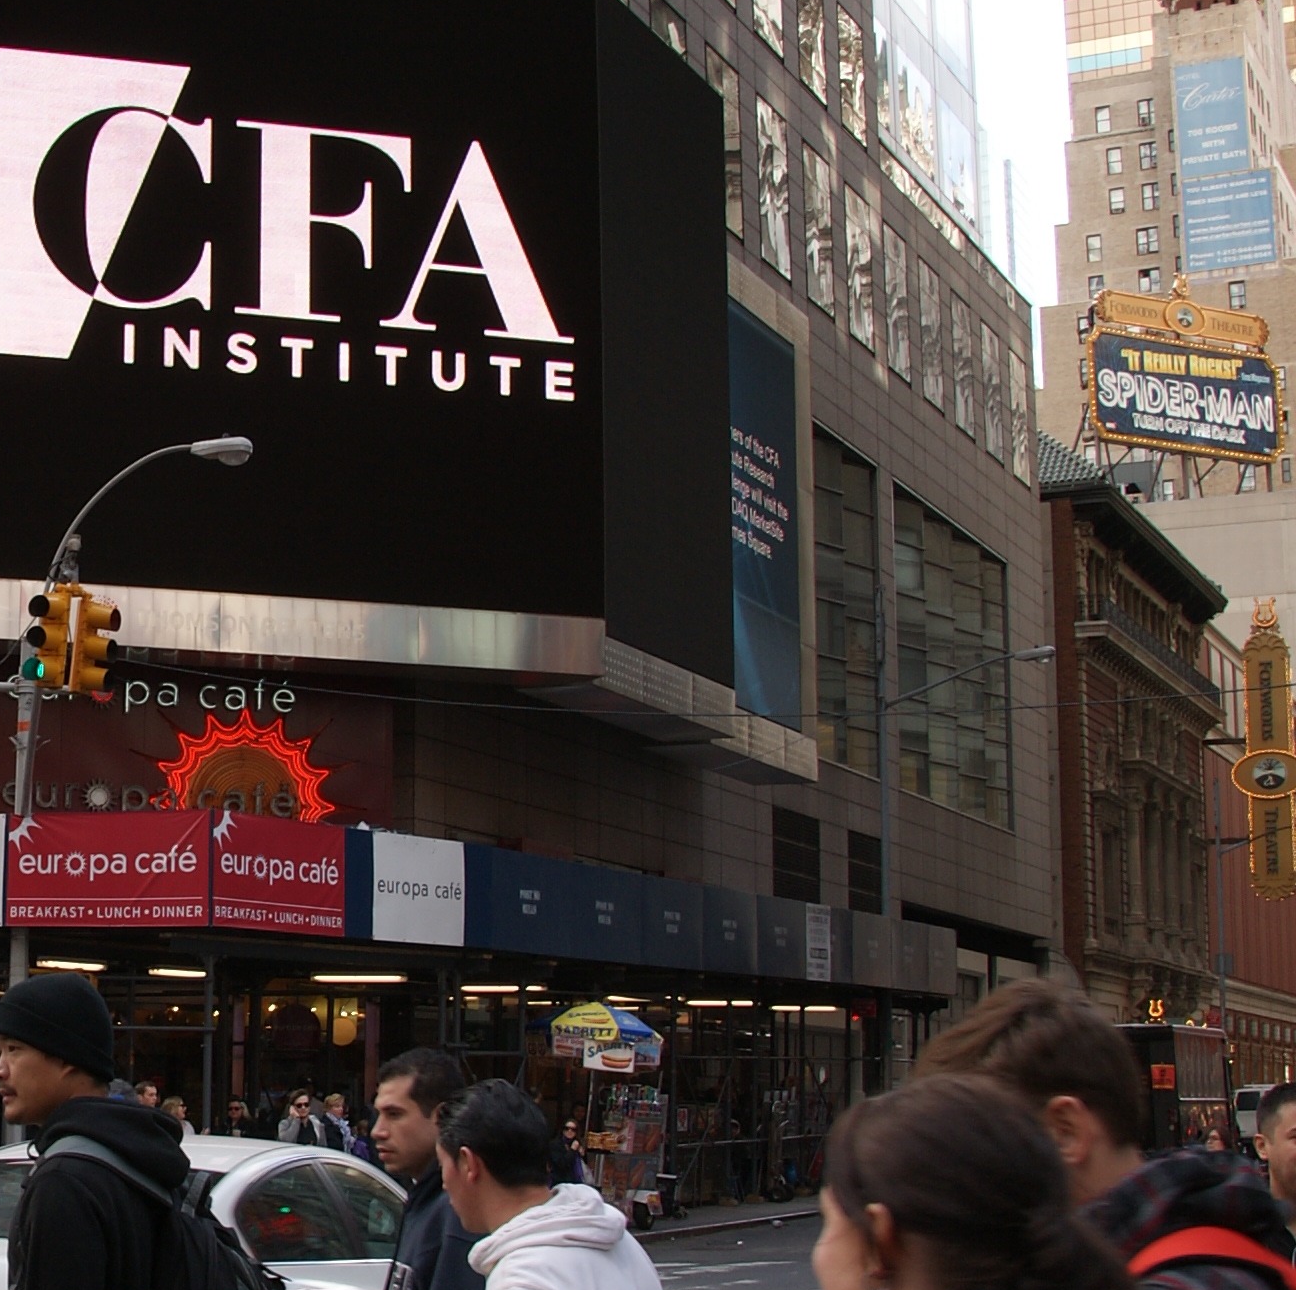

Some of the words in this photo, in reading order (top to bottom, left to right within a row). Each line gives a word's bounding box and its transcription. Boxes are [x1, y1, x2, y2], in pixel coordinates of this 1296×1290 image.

[1182, 152, 1220, 165] PRIVATE
[1222, 149, 1247, 159] BATH
[32, 104, 575, 345] CFA
[1211, 317, 1255, 337] THEATRE
[122, 322, 576, 402] INSTITUTE
[1097, 368, 1275, 433] SPIDER-MAN
[1132, 412, 1165, 432] TURN
[1165, 418, 1189, 436] OFF
[1189, 421, 1211, 439] THE
[1210, 425, 1247, 445] DARK
[753, 438, 764, 460] the
[764, 445, 781, 469] CFA
[744, 455, 775, 489] Research
[777, 501, 789, 521] the
[199, 679, 296, 713] café
[18, 850, 128, 882] europa
[134, 842, 198, 874] café
[220, 850, 297, 886] europa
[298, 857, 339, 886] café
[377, 875, 429, 900] europa
[434, 880, 462, 902] café
[9, 905, 86, 920] BREAKFAST
[96, 905, 142, 920] LUNCH
[152, 904, 204, 919] DINNER
[214, 905, 266, 922] BREAKFAST
[273, 909, 304, 926] LUNCH
[310, 912, 343, 928] DINNER
[554, 1024, 614, 1038] SABRETT
